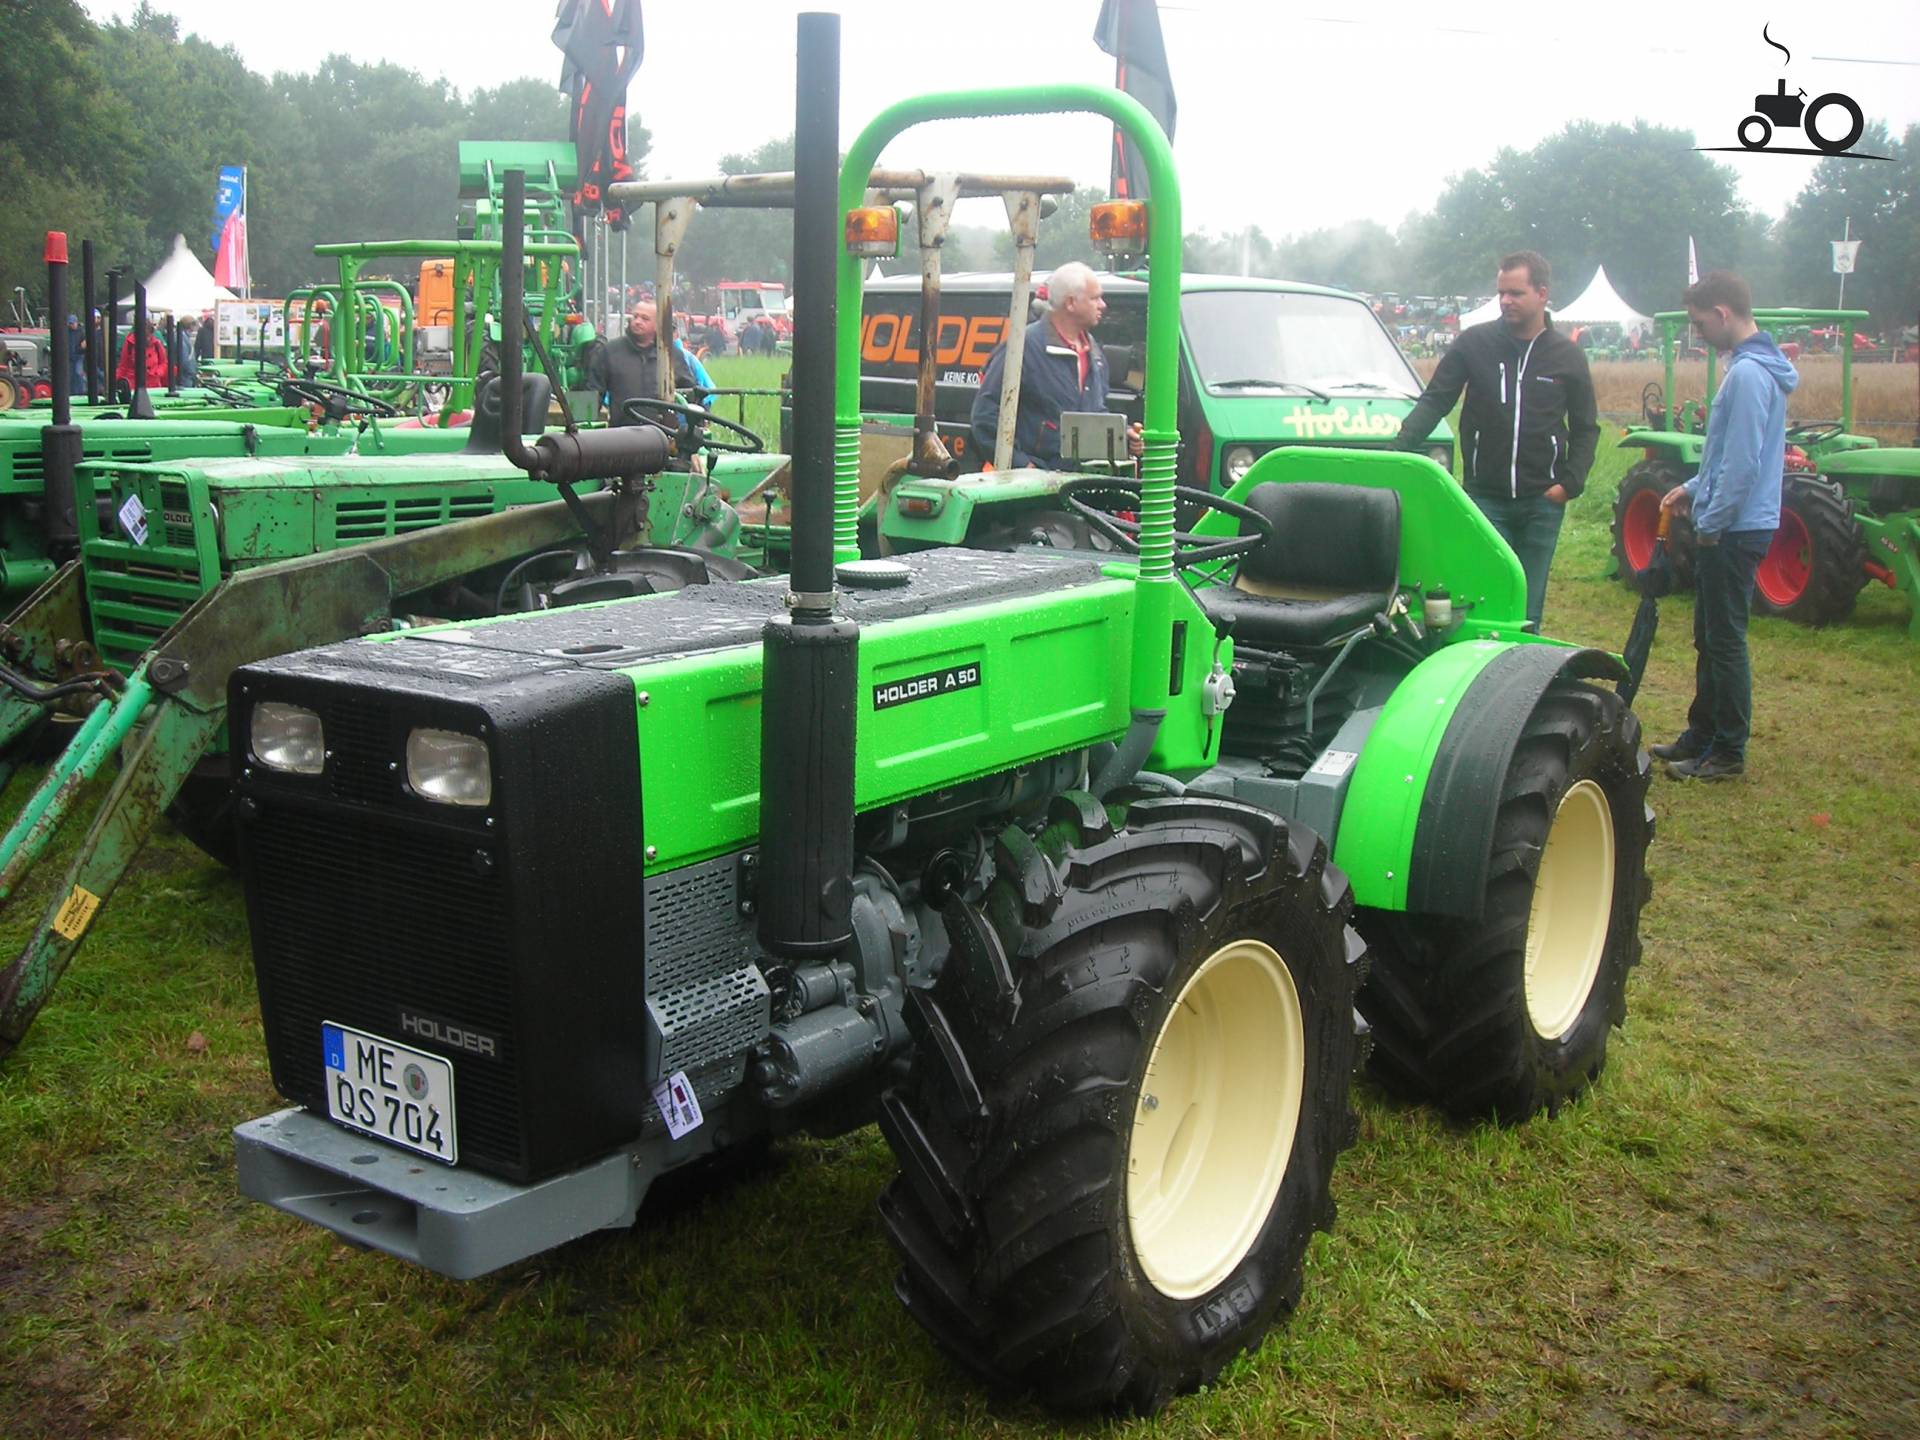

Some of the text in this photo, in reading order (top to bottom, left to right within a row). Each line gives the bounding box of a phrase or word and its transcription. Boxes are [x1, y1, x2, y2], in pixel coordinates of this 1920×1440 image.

[861, 314, 1010, 366] OLDE
[1283, 405, 1401, 438] Holder
[876, 677, 938, 704] HOLDER
[401, 1013, 495, 1057] HOLDER
[356, 1039, 398, 1091] ME
[337, 1079, 443, 1152] QS 704
